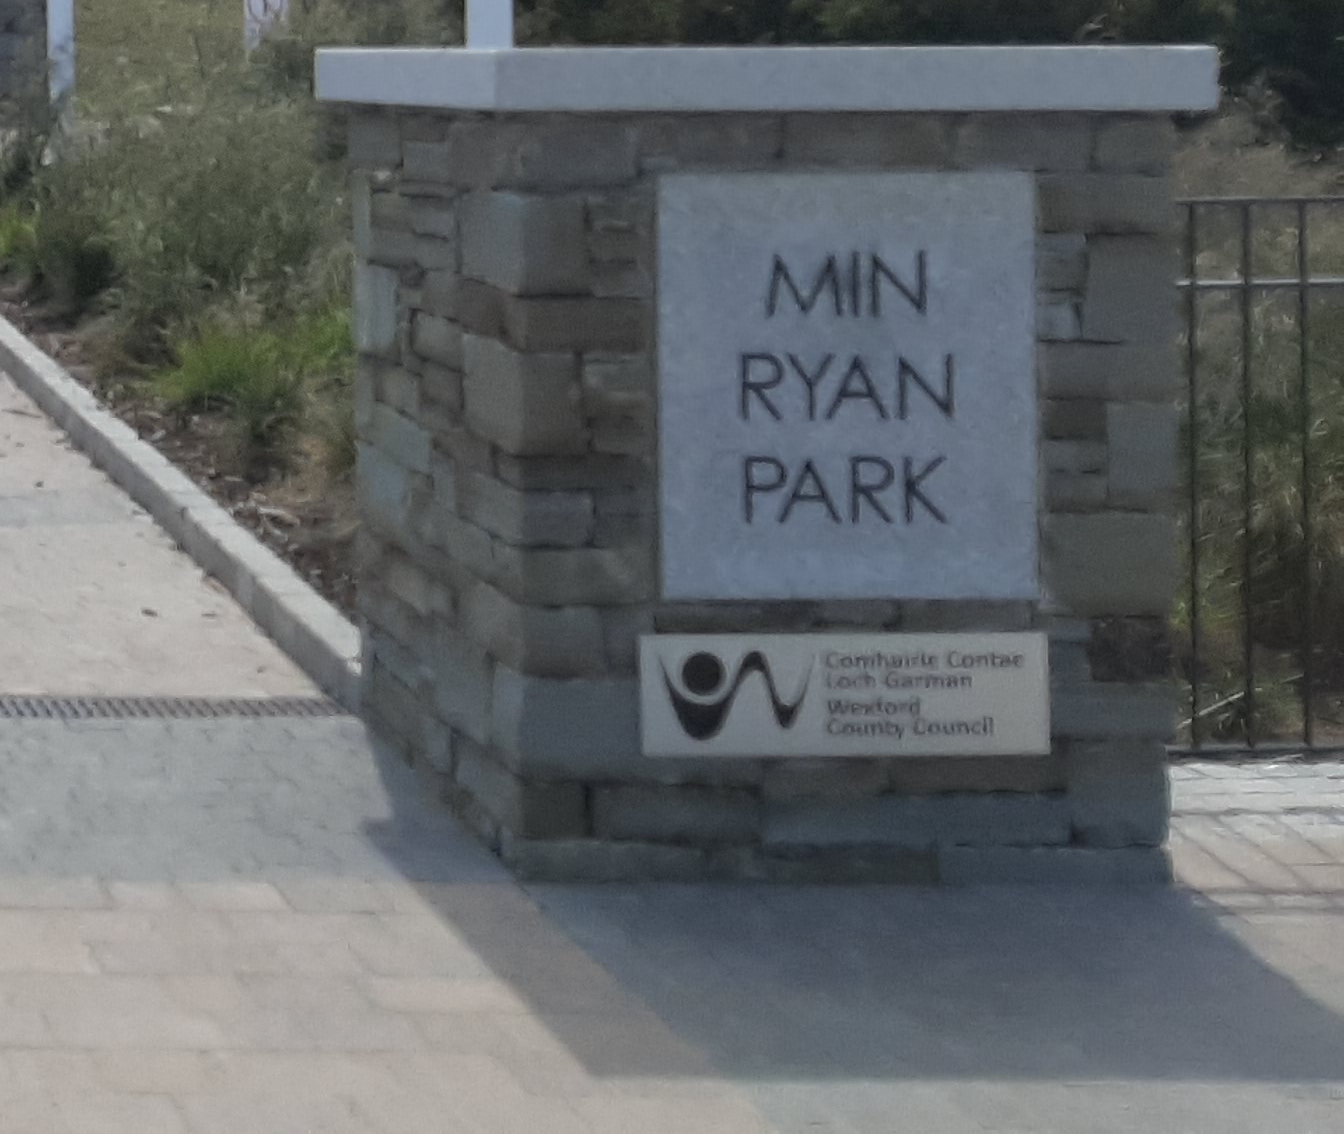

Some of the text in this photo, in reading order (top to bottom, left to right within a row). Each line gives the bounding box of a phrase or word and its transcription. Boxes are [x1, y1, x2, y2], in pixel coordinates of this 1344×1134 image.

[764, 249, 928, 318] MIN
[738, 352, 955, 422] RYAN
[742, 455, 948, 525] PARK
[947, 651, 1025, 669] Contae
[826, 671, 973, 689] Loch Garman
[827, 696, 922, 715] Wexford
[826, 716, 995, 739] County Council
